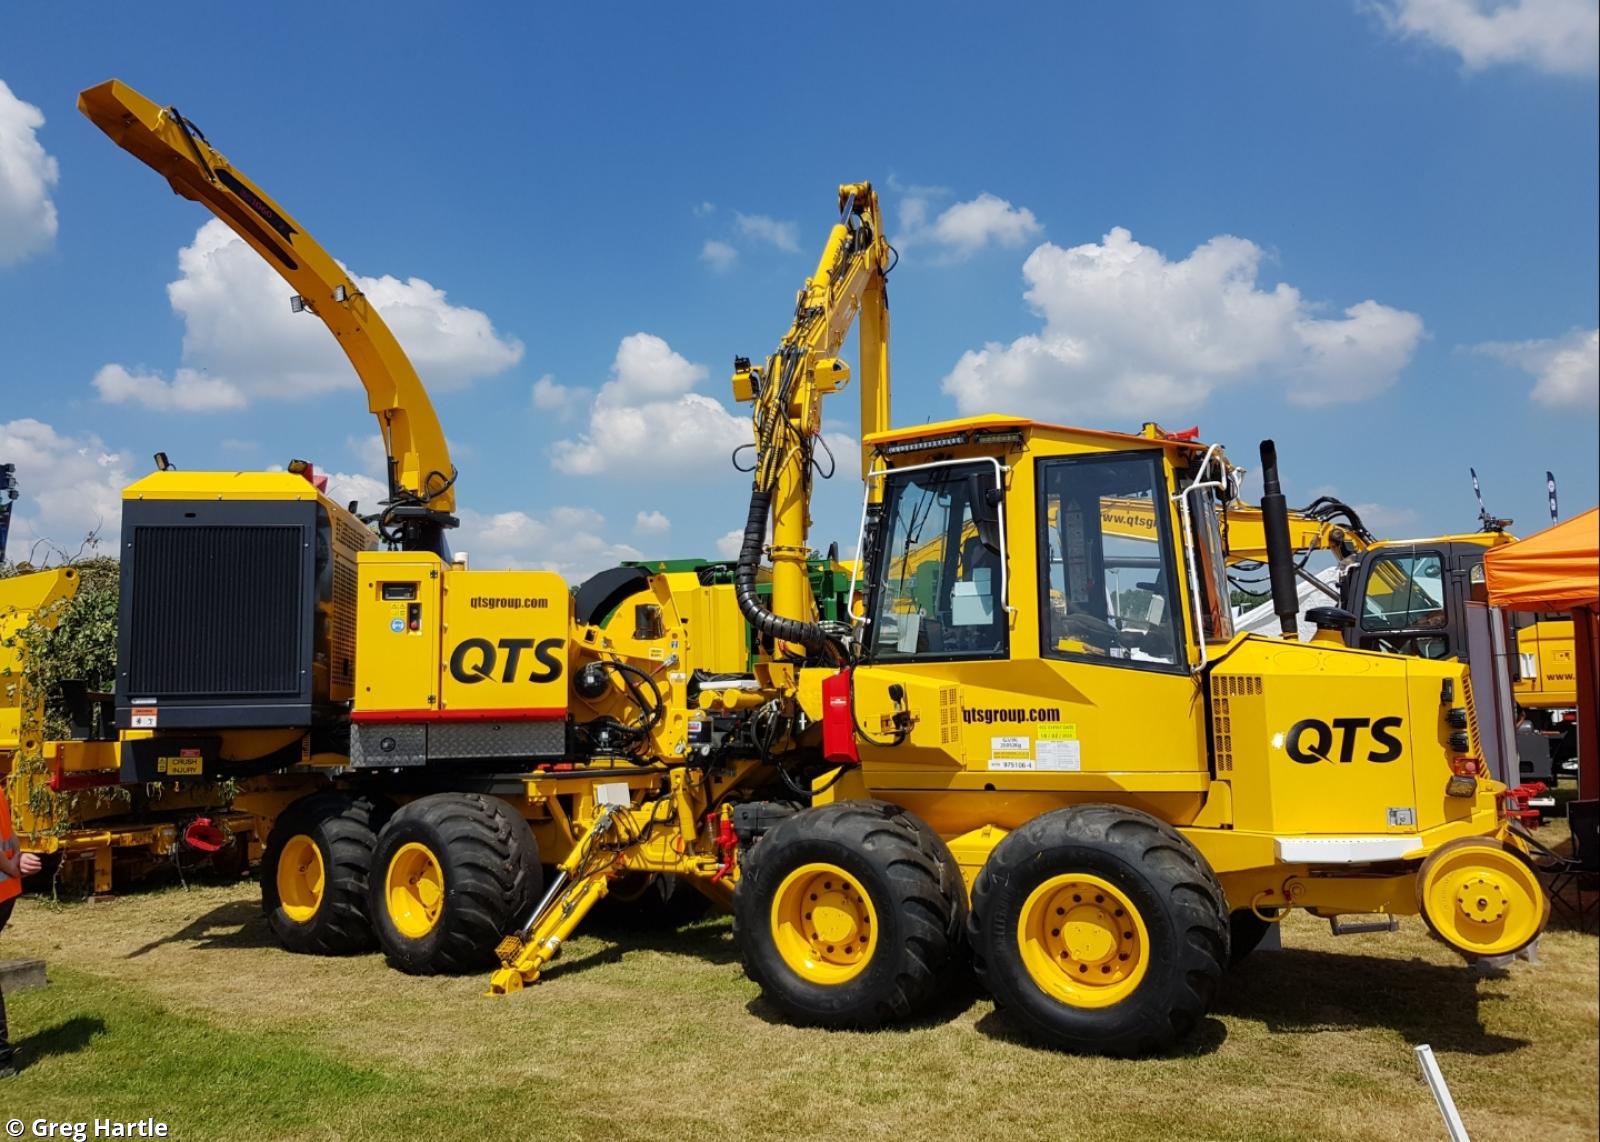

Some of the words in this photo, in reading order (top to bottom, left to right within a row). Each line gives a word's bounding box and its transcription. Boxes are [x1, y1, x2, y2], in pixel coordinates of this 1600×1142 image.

[470, 596, 549, 610] qtsgroup.com
[449, 637, 566, 684] QTS
[962, 706, 1060, 725] qtsgroup.com
[1285, 716, 1403, 765] QTS
